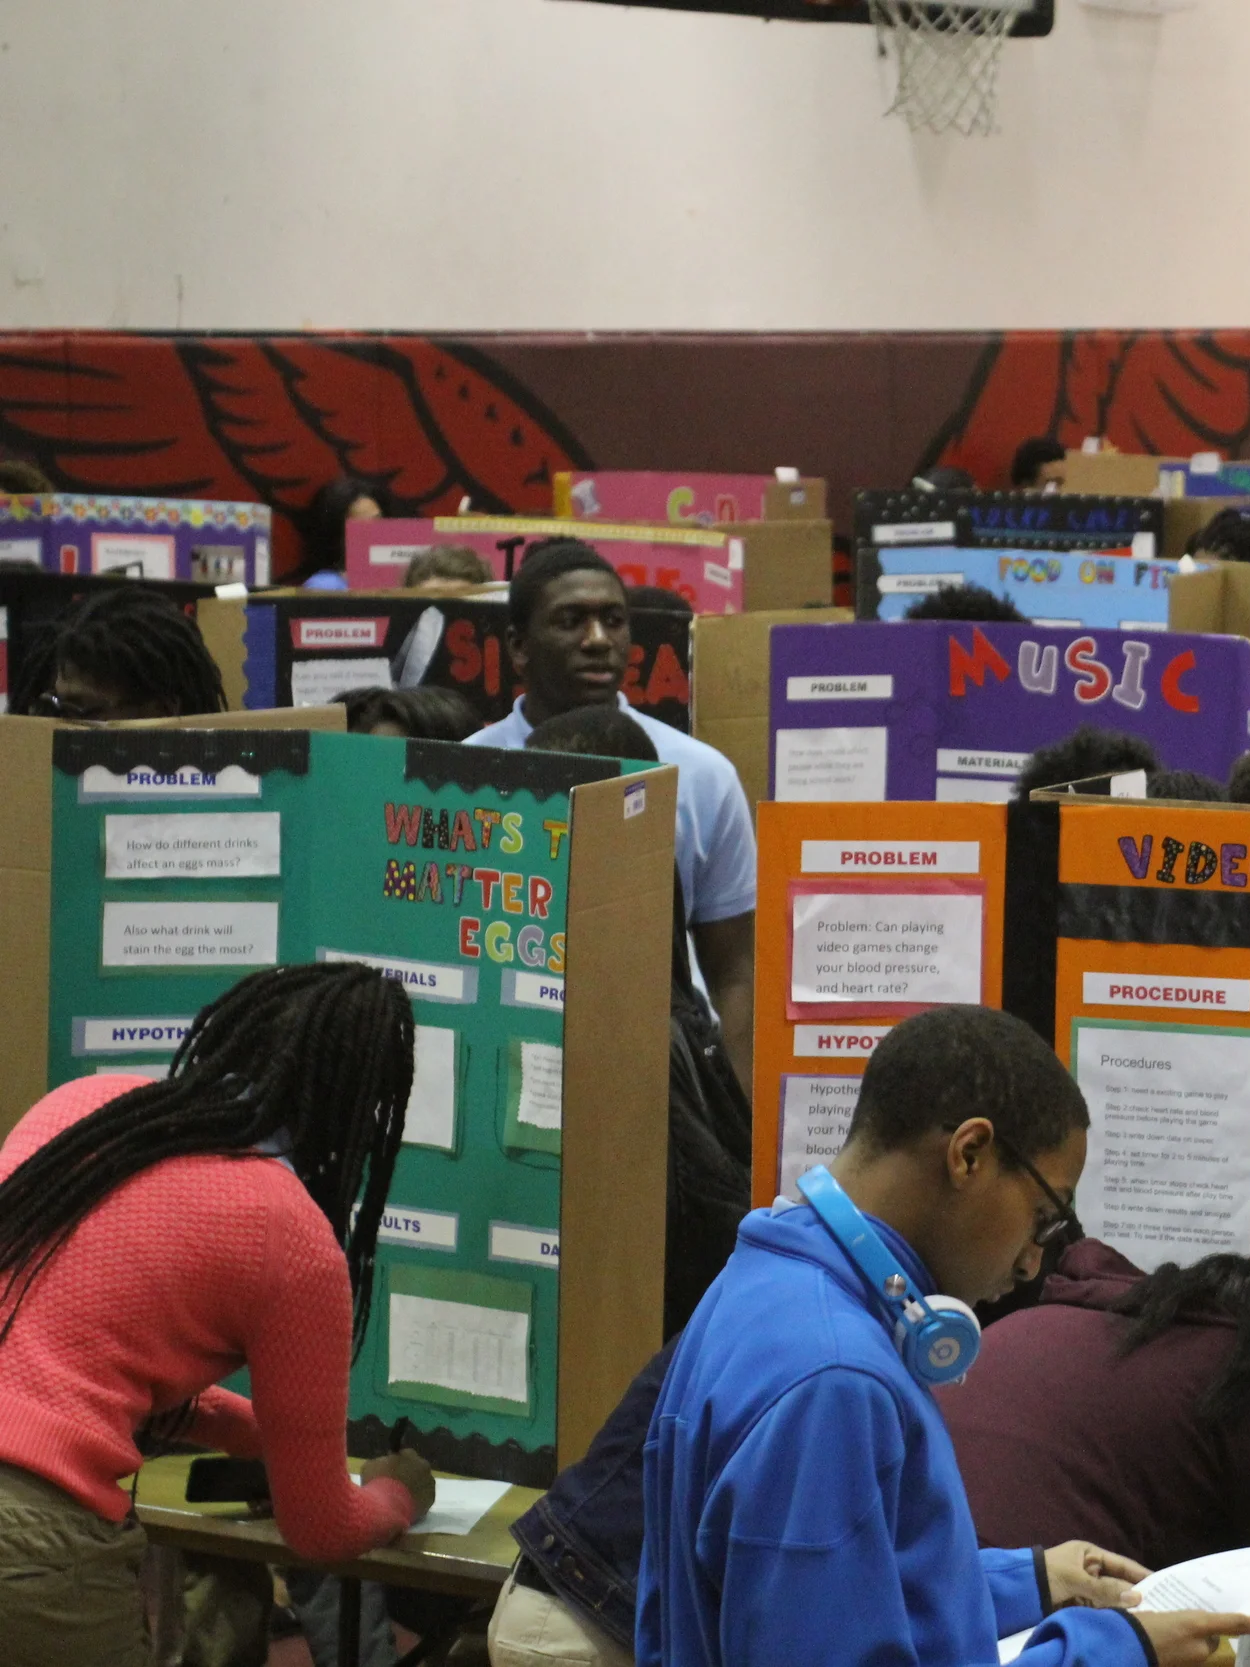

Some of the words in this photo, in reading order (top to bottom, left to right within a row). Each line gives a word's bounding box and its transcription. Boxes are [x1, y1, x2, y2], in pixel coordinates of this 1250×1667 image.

[998, 556, 1062, 583] FOOD
[1079, 559, 1115, 585] ON
[305, 628, 372, 638] PROBLEM
[949, 626, 1200, 713] MUSIC
[810, 681, 868, 694] PROBLEM
[957, 756, 1023, 769] MATERIAL
[126, 772, 217, 786] PROBLEM
[384, 802, 523, 854] WHATS
[126, 839, 152, 851] How
[155, 839, 170, 850] do
[172, 838, 221, 850] different
[224, 838, 258, 849] drinks
[126, 859, 158, 870] affect
[162, 860, 175, 869] an
[178, 860, 203, 871] eggs
[206, 857, 241, 868] mass?
[840, 851, 938, 865] PROBLEM
[384, 859, 552, 919] MATTER
[123, 924, 147, 936] Also
[150, 924, 179, 936] what
[182, 924, 210, 936] drink
[212, 924, 233, 936] will
[817, 921, 871, 933] Problem:
[875, 921, 898, 933] Can
[901, 921, 944, 935] playing
[123, 944, 150, 954] stain
[153, 944, 172, 954] the
[175, 945, 195, 956] egg
[198, 943, 216, 954] the
[219, 944, 254, 955] most?
[816, 942, 849, 952] video
[852, 943, 892, 955] games
[895, 942, 938, 955] change
[816, 963, 843, 975] your
[846, 962, 881, 973] blood
[884, 963, 940, 975] pressure,
[815, 982, 839, 993] and
[841, 982, 873, 993] heart
[877, 982, 908, 993] rate?
[1109, 984, 1226, 1004] PROCEDURE
[1100, 1054, 1172, 1070] Procedures
[810, 1083, 861, 1096] Hypothe
[808, 1104, 851, 1117] playing
[807, 1125, 833, 1136] your
